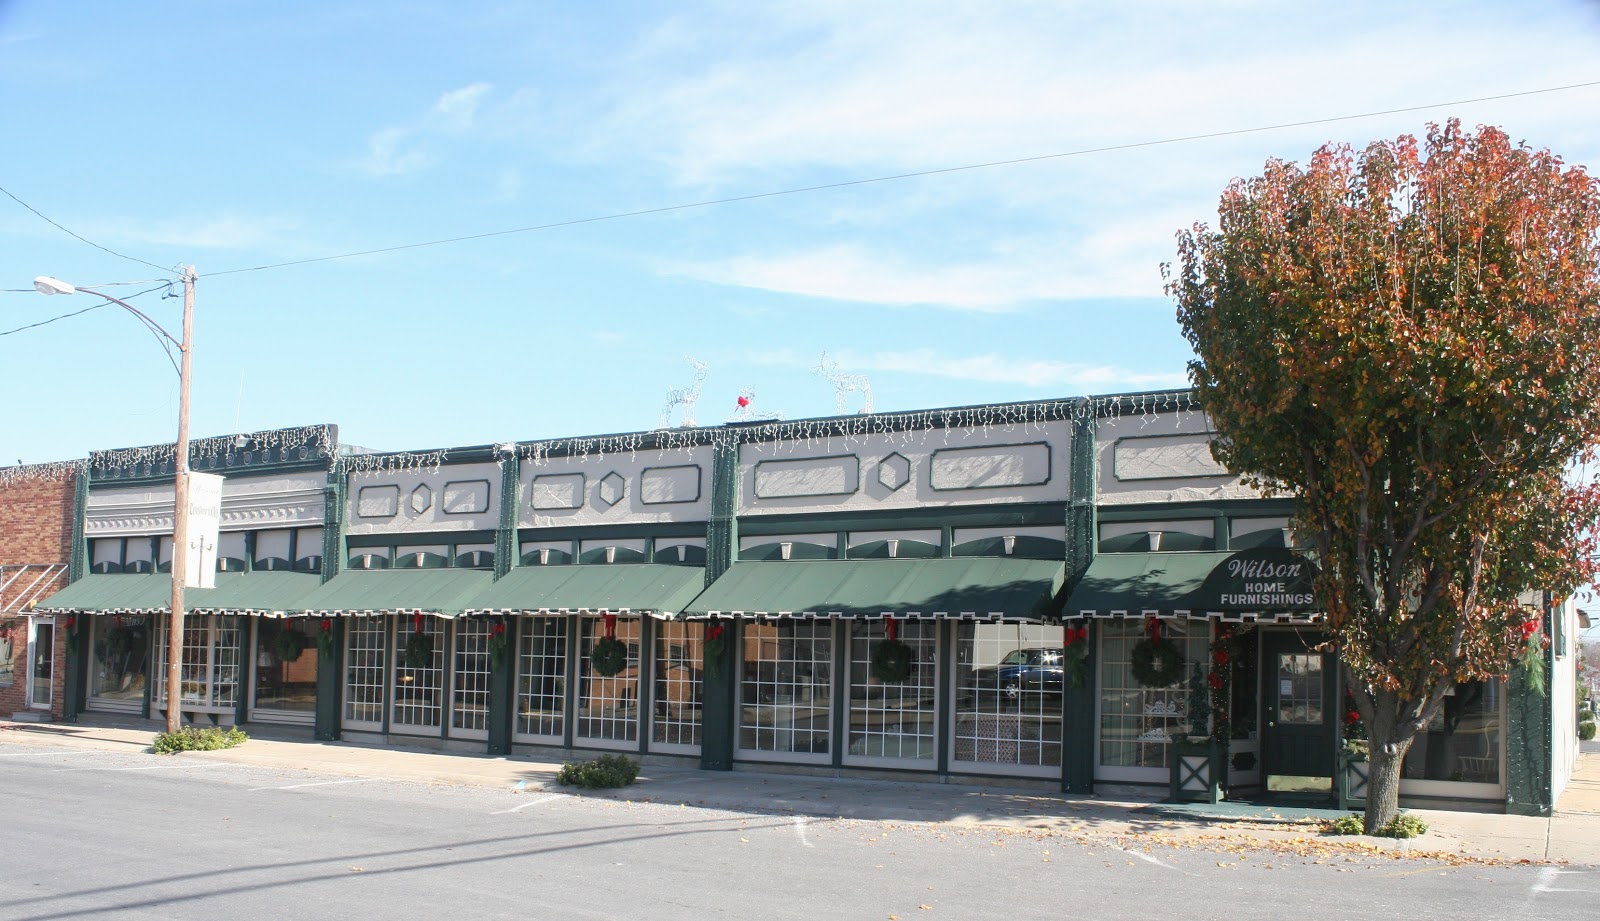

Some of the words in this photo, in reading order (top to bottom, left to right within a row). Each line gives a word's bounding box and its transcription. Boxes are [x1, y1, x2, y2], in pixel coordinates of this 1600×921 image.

[1228, 559, 1301, 578] Wilson
[1245, 582, 1286, 593] HOME
[1221, 593, 1314, 605] FURNISHINGS
